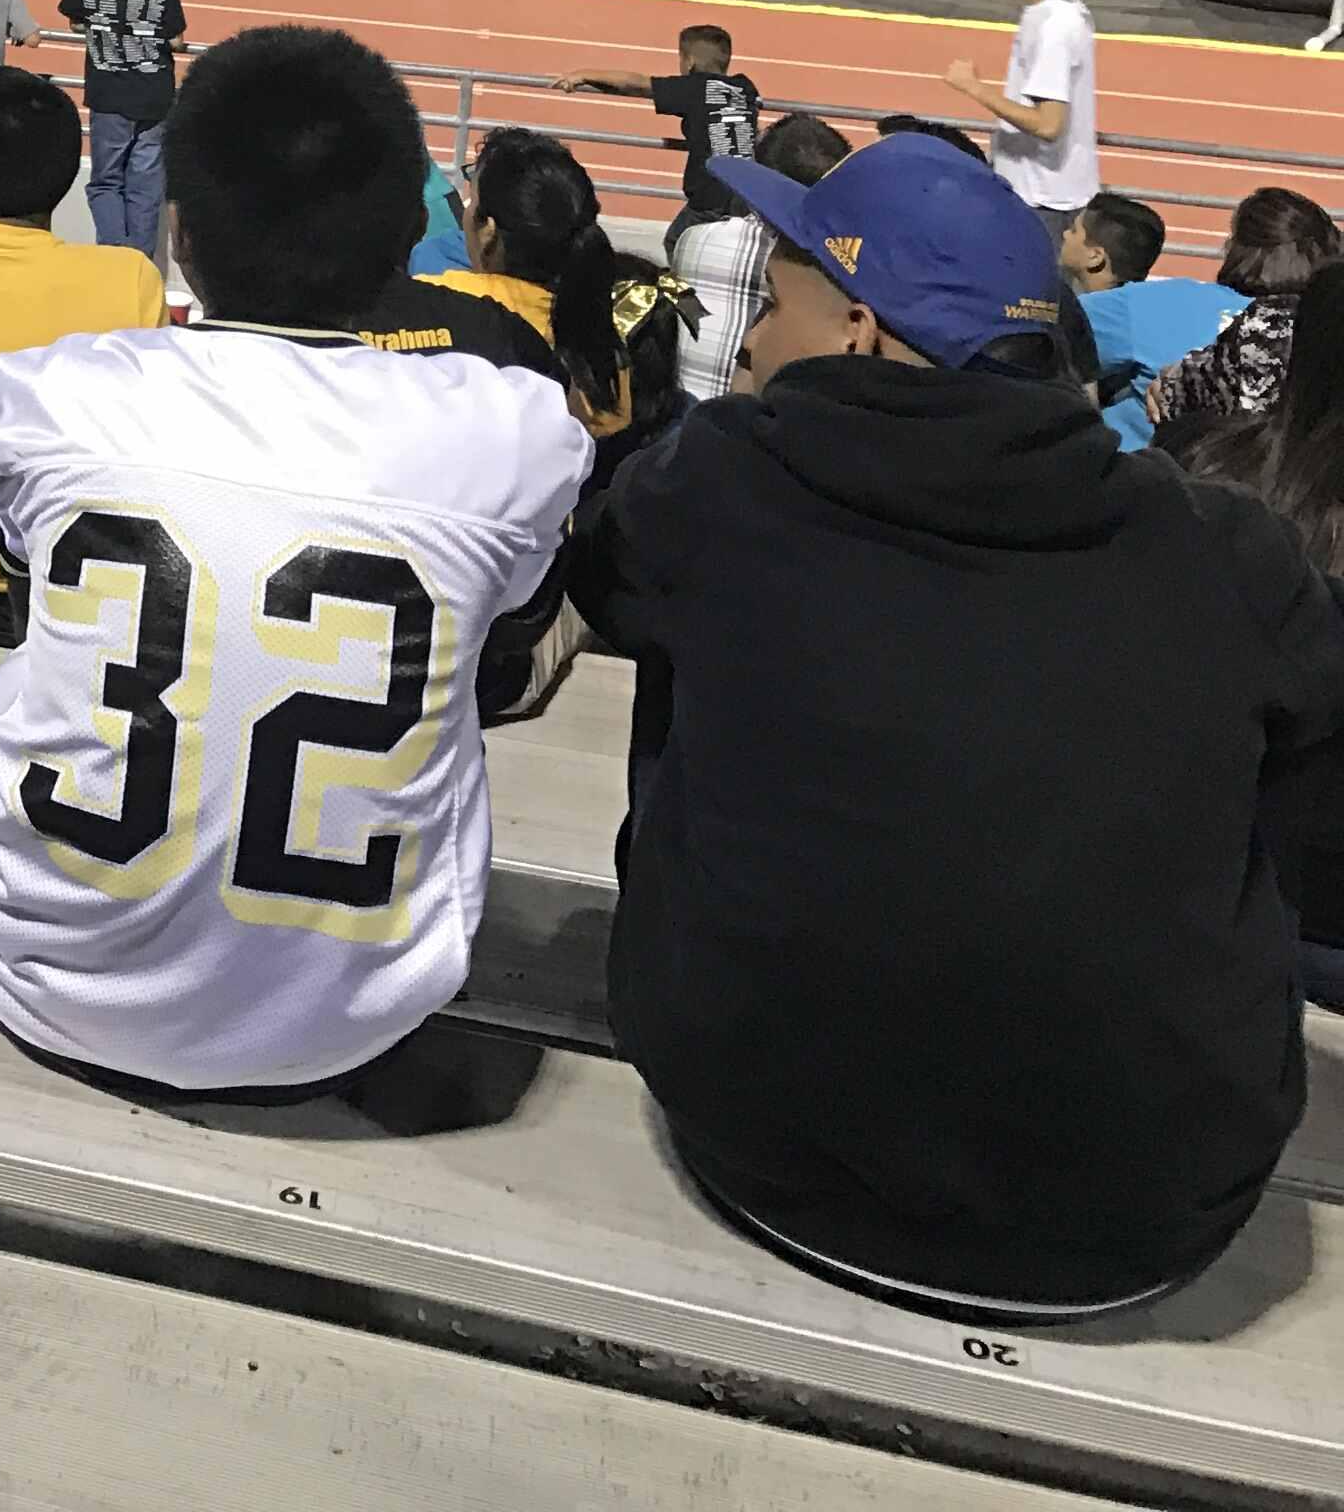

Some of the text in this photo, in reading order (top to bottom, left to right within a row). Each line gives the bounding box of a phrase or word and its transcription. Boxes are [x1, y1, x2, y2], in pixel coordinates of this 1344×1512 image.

[824, 237, 857, 275] adidas
[358, 328, 452, 351] Brahma
[13, 496, 452, 943] 32
[279, 1186, 323, 1211] 19
[962, 1338, 1020, 1367] 20
